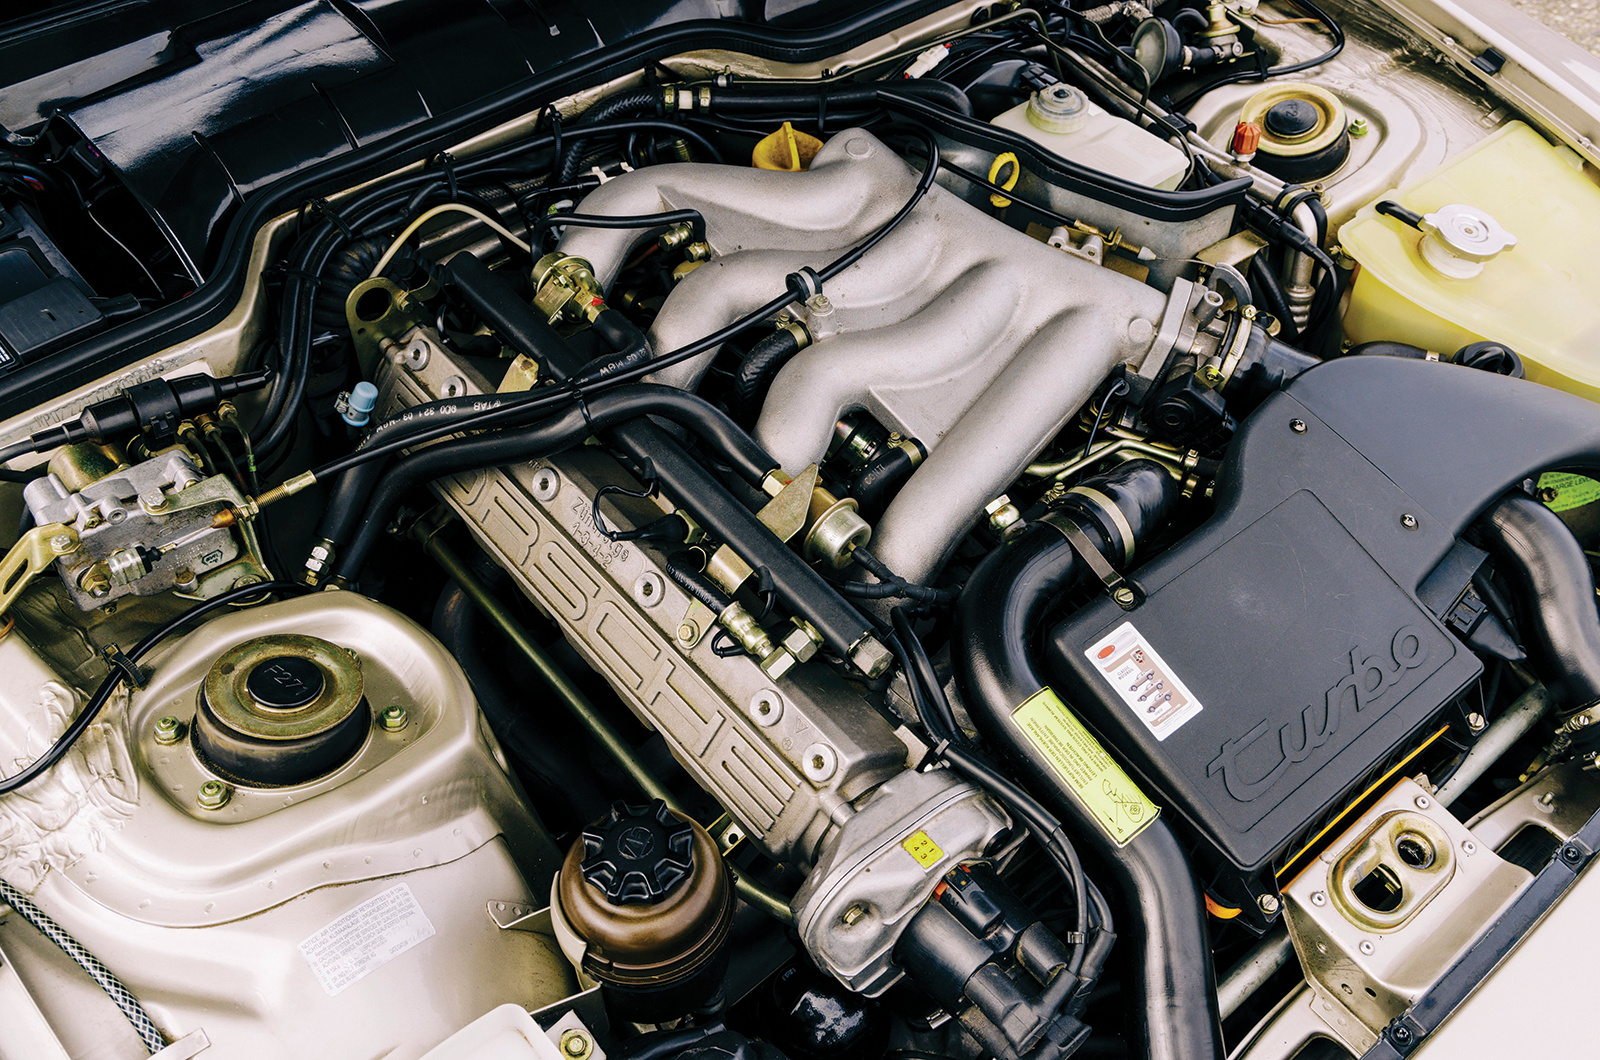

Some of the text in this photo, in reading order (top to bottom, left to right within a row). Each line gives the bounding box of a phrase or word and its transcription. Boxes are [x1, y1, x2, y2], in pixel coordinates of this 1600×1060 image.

[1206, 624, 1430, 804] turbo
[920, 839, 928, 847] 2
[920, 852, 927, 860] 3
